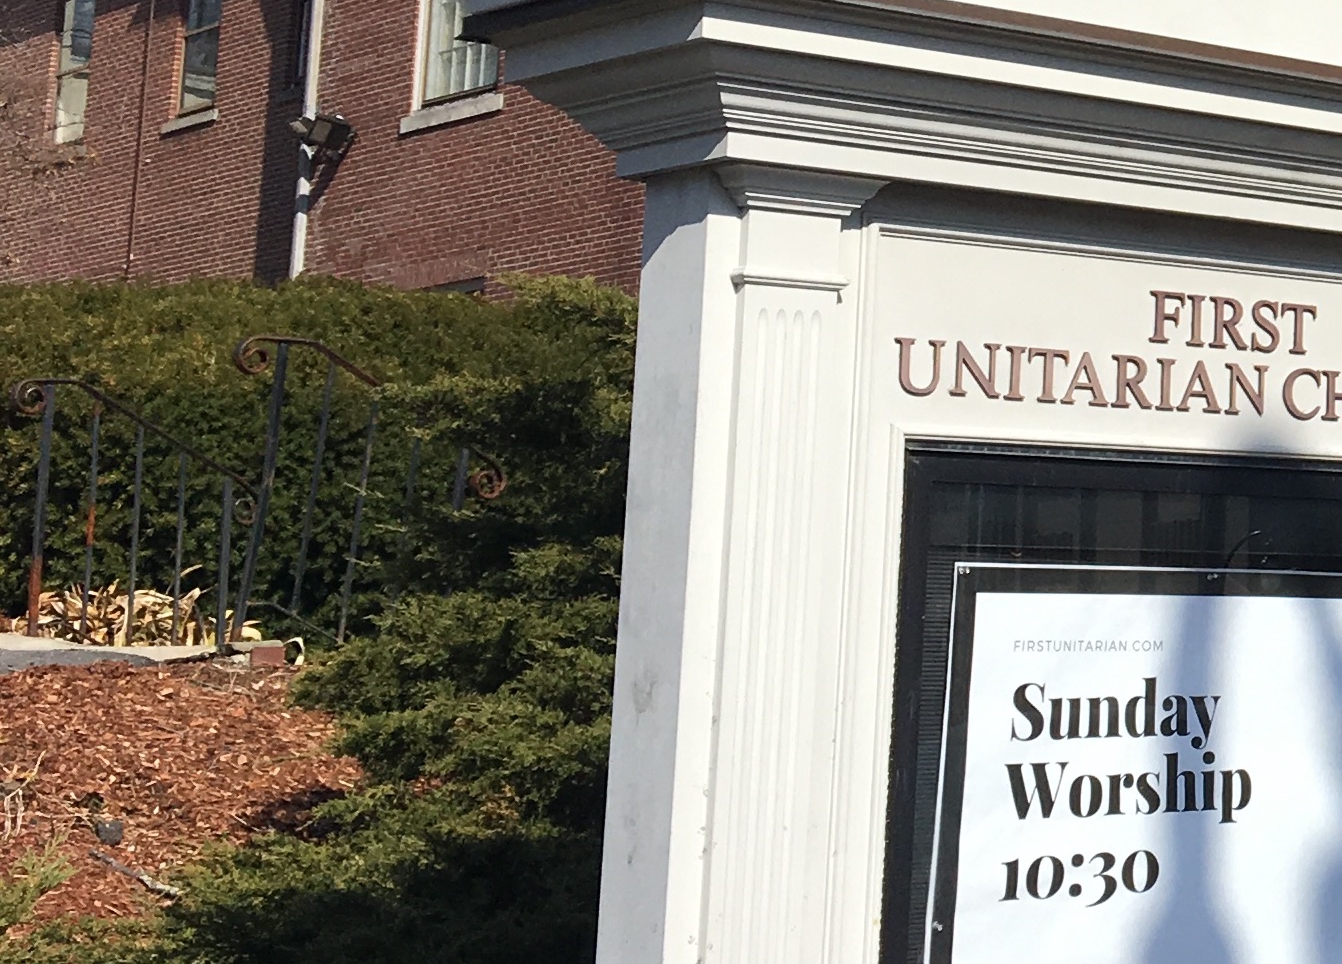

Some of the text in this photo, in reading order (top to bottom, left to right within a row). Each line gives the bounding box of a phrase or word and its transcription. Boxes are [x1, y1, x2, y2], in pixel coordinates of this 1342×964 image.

[1148, 290, 1318, 356] FIRST
[894, 337, 1269, 417] UNITARIAN
[1012, 639, 1164, 653] FIRSTUNITARIAN.COM
[1010, 677, 1222, 750] Sunday
[1005, 751, 1253, 824] Worship
[999, 849, 1161, 906] 10:30
